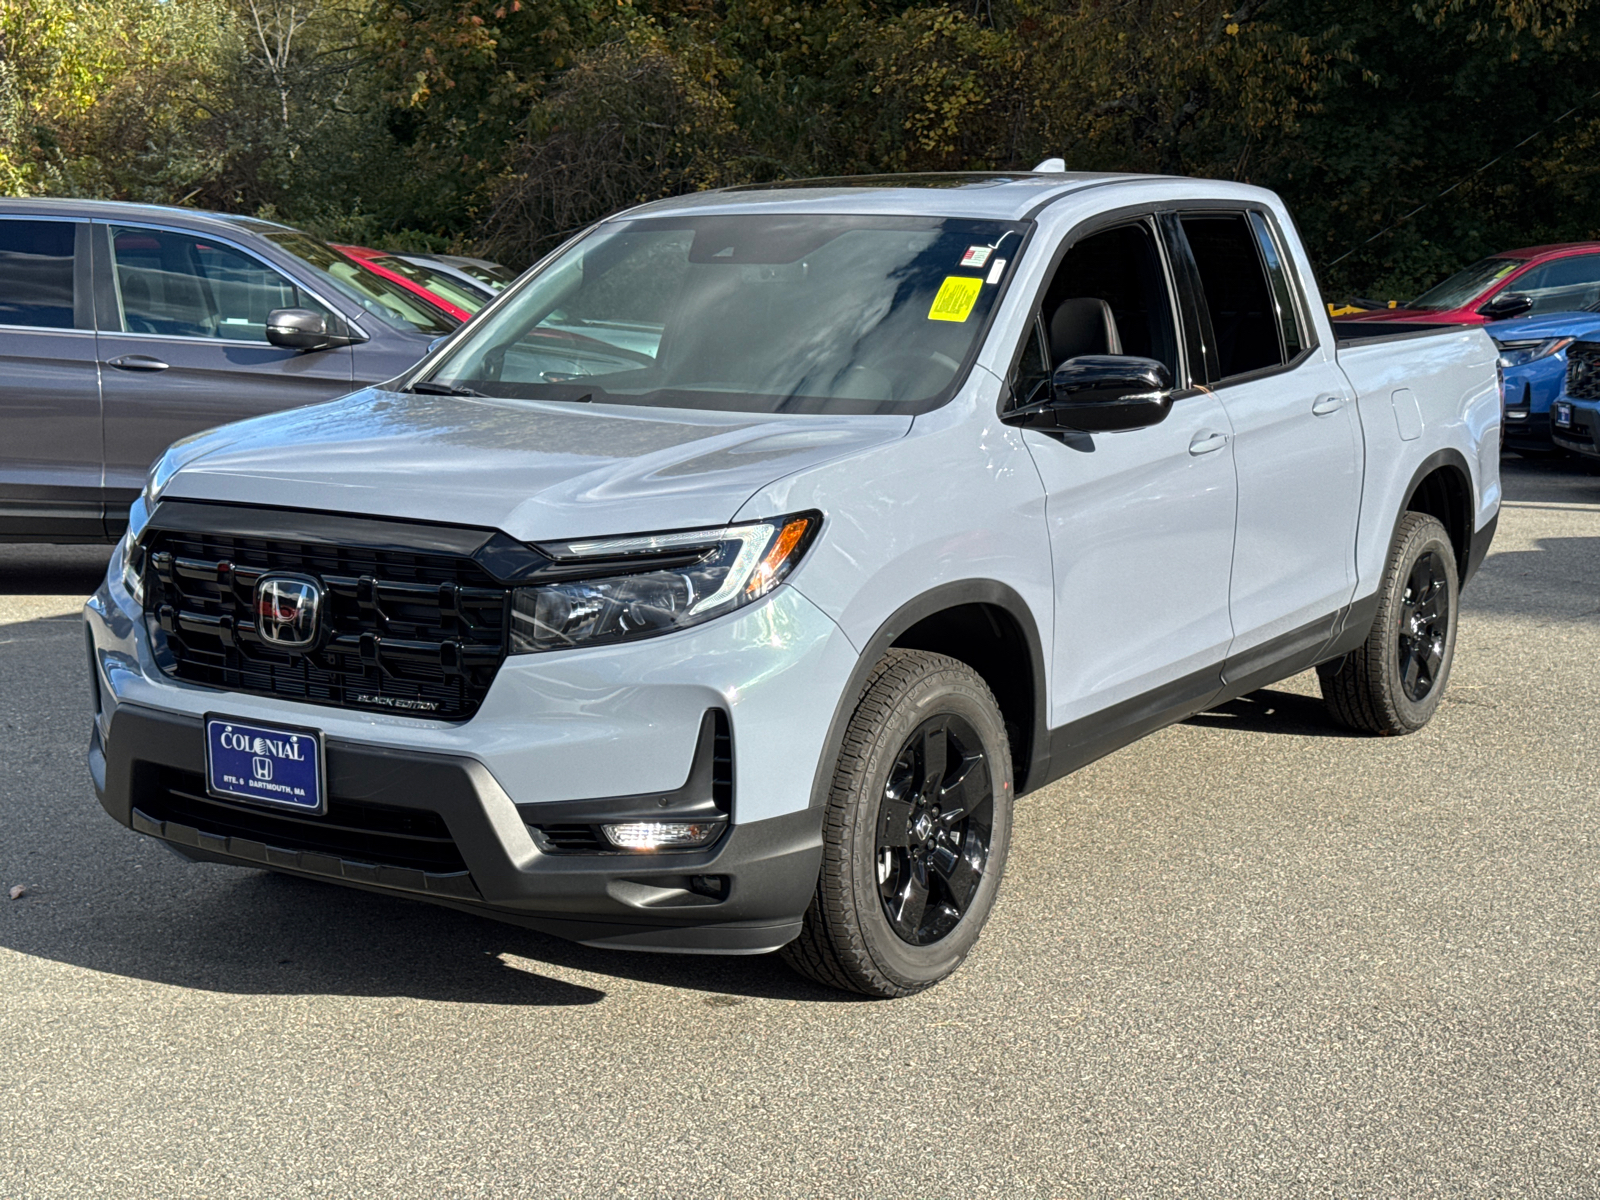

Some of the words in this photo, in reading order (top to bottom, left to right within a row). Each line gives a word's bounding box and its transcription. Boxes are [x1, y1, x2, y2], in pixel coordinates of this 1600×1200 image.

[357, 694, 395, 706] BLACK
[395, 699, 439, 711] EDITION
[220, 731, 304, 761] COLONIAL
[223, 775, 238, 784] RTE.
[249, 779, 293, 795] DARTMOUTH,
[294, 787, 305, 796] MA
